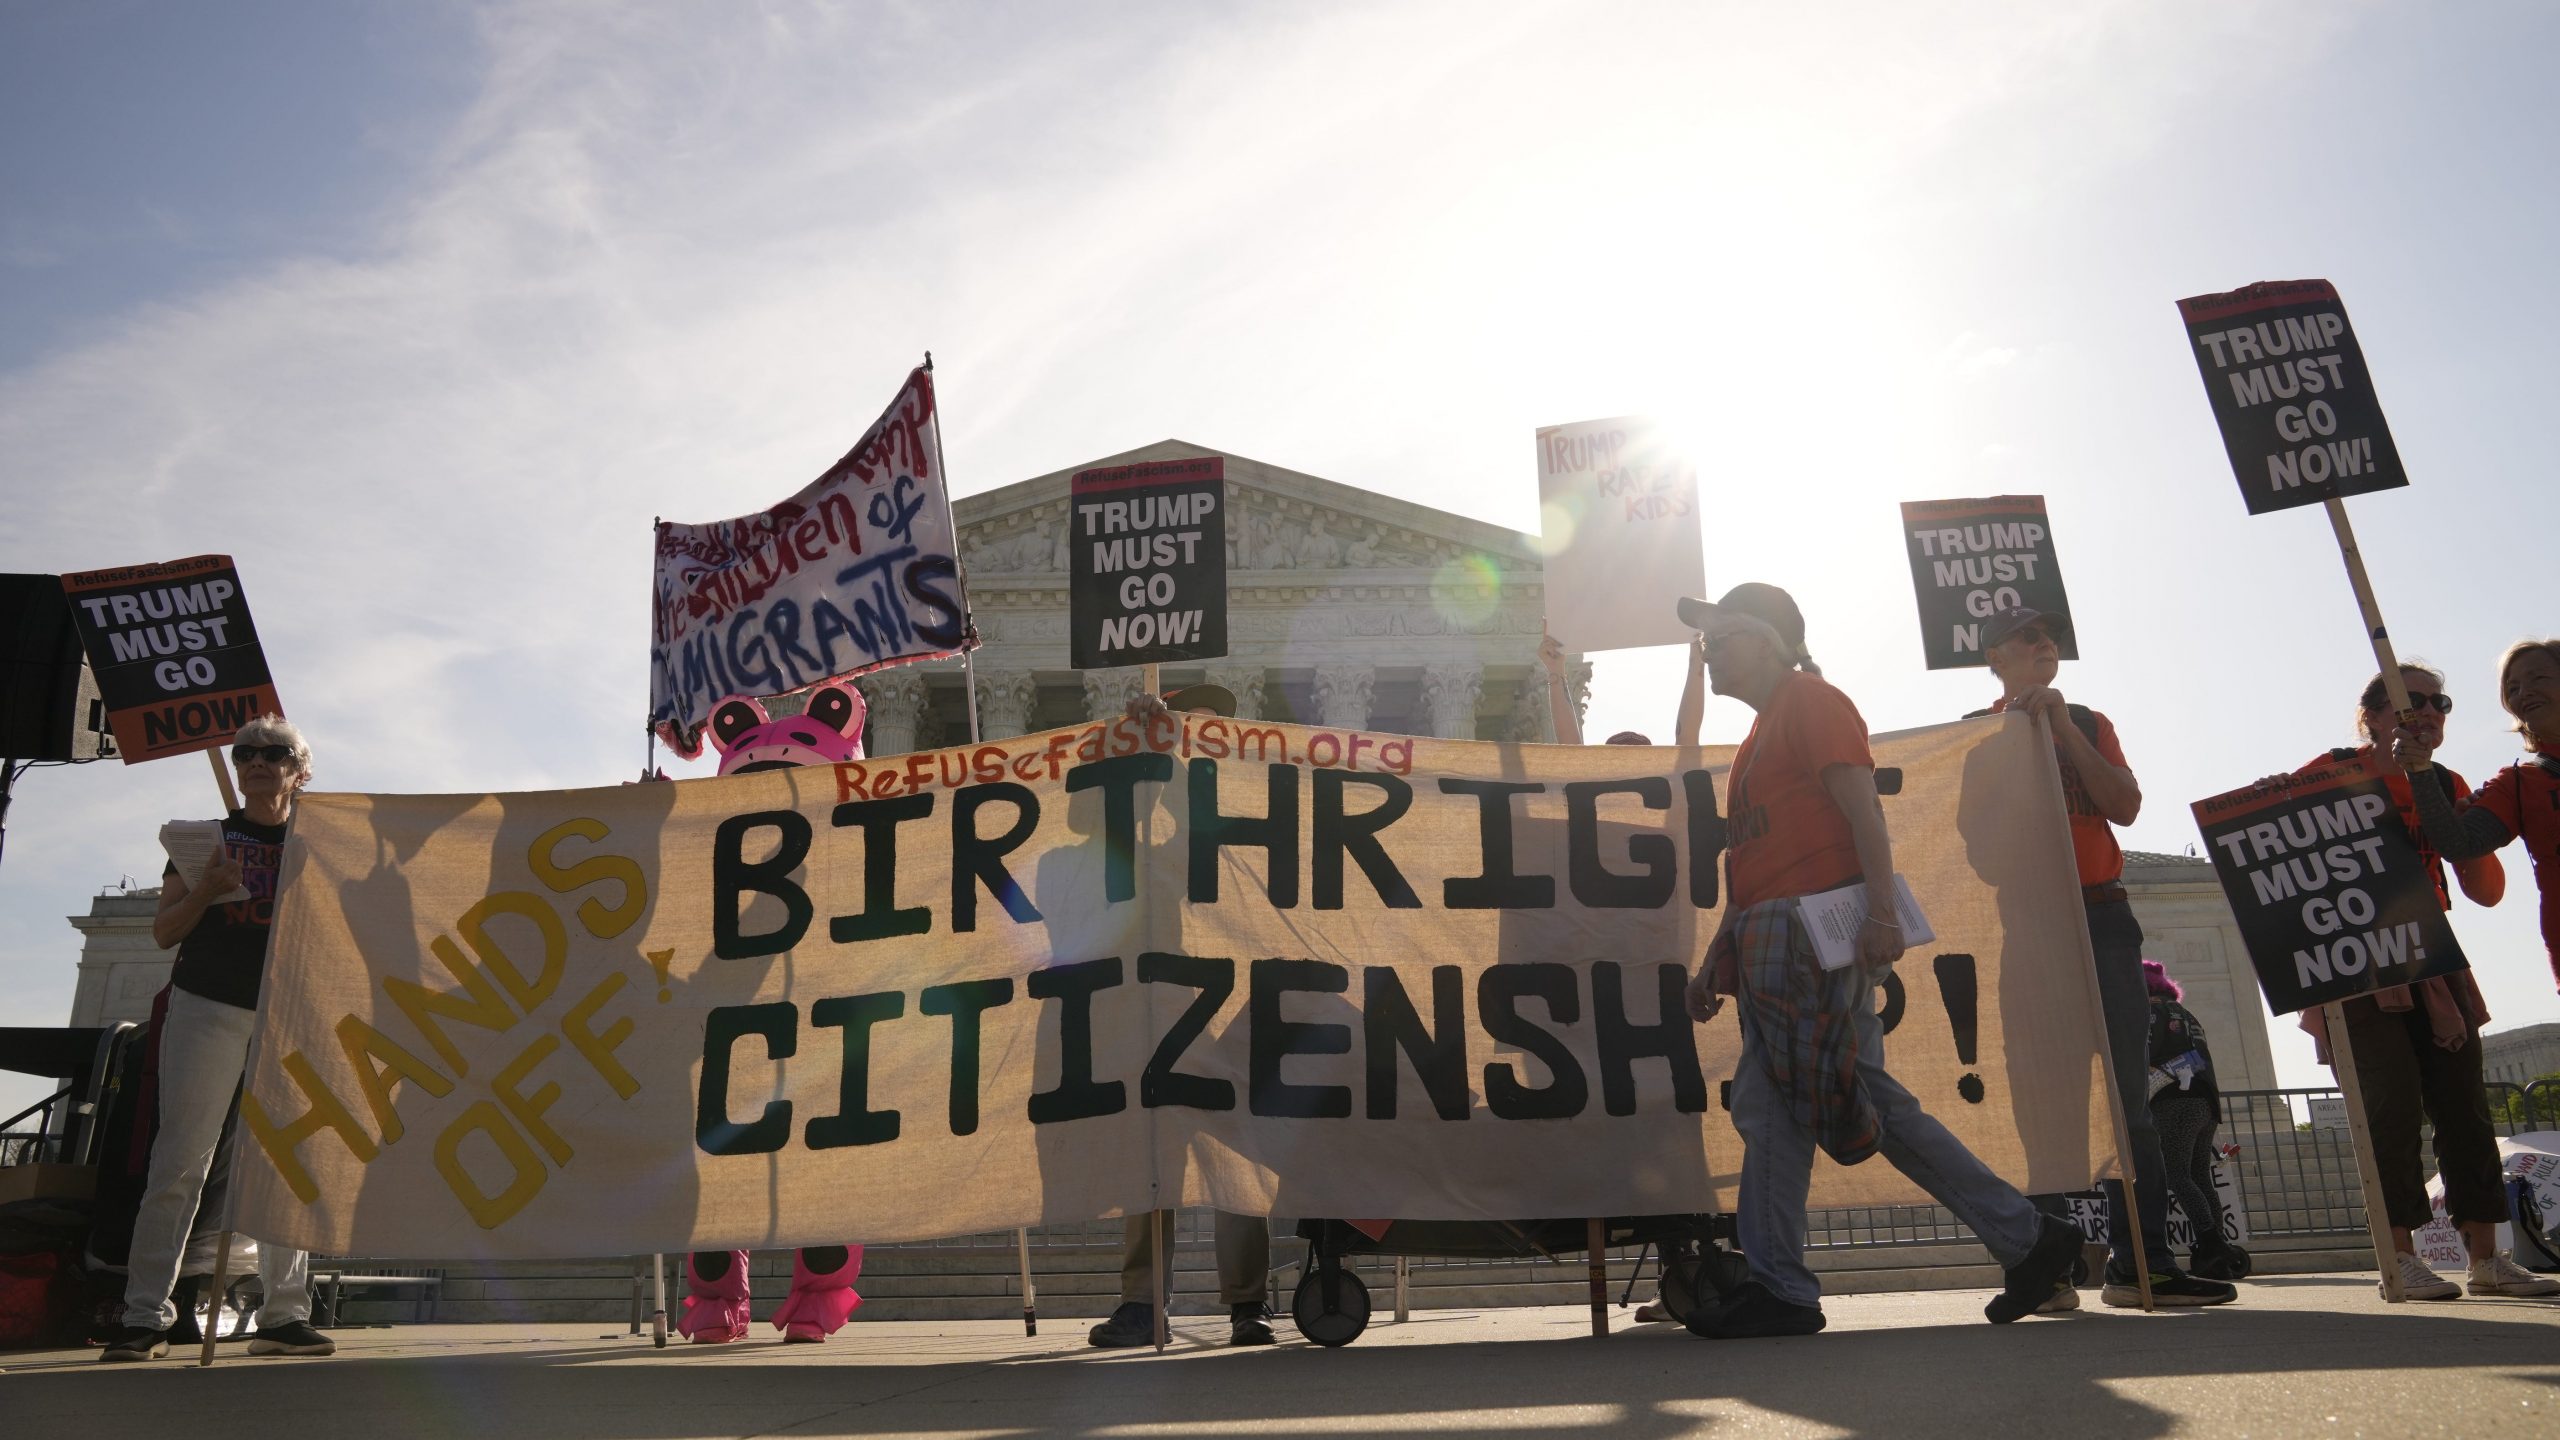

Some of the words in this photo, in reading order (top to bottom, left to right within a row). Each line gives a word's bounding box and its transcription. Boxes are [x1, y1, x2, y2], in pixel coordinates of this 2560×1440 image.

[2199, 313, 2343, 367] TRUMP
[2229, 355, 2344, 408] MUST
[2275, 399, 2337, 442] GO
[1536, 427, 1626, 474] TRUMP
[2266, 437, 2376, 491] NOW!
[1081, 462, 1212, 484] RefuseFascism.org
[868, 475, 925, 544] of
[1079, 493, 1215, 536] TRUMP
[1625, 495, 1691, 523] KIDS
[1093, 532, 1202, 573] MUST
[1914, 522, 2045, 557] TRUMP
[73, 556, 220, 588] RefuseFascism.org
[1120, 572, 1176, 609] GO
[1933, 554, 2039, 588] MUST
[80, 579, 234, 628] TRUMP
[1965, 587, 2022, 618] GO
[108, 616, 230, 662] MUST
[1099, 610, 1203, 652] NOW!
[154, 656, 216, 691] GO
[143, 694, 260, 746] NOW!
[2215, 793, 2386, 868] TRUMP
[2248, 836, 2386, 906] MUST
[2301, 887, 2376, 936] GO
[2292, 921, 2427, 989] NOW!
[240, 817, 648, 1206] HANDS
[433, 947, 676, 1230] OFF!
[2532, 1155, 2560, 1181] RULE
[2539, 1192, 2558, 1210] OF
[2425, 1230, 2457, 1246] HONEST
